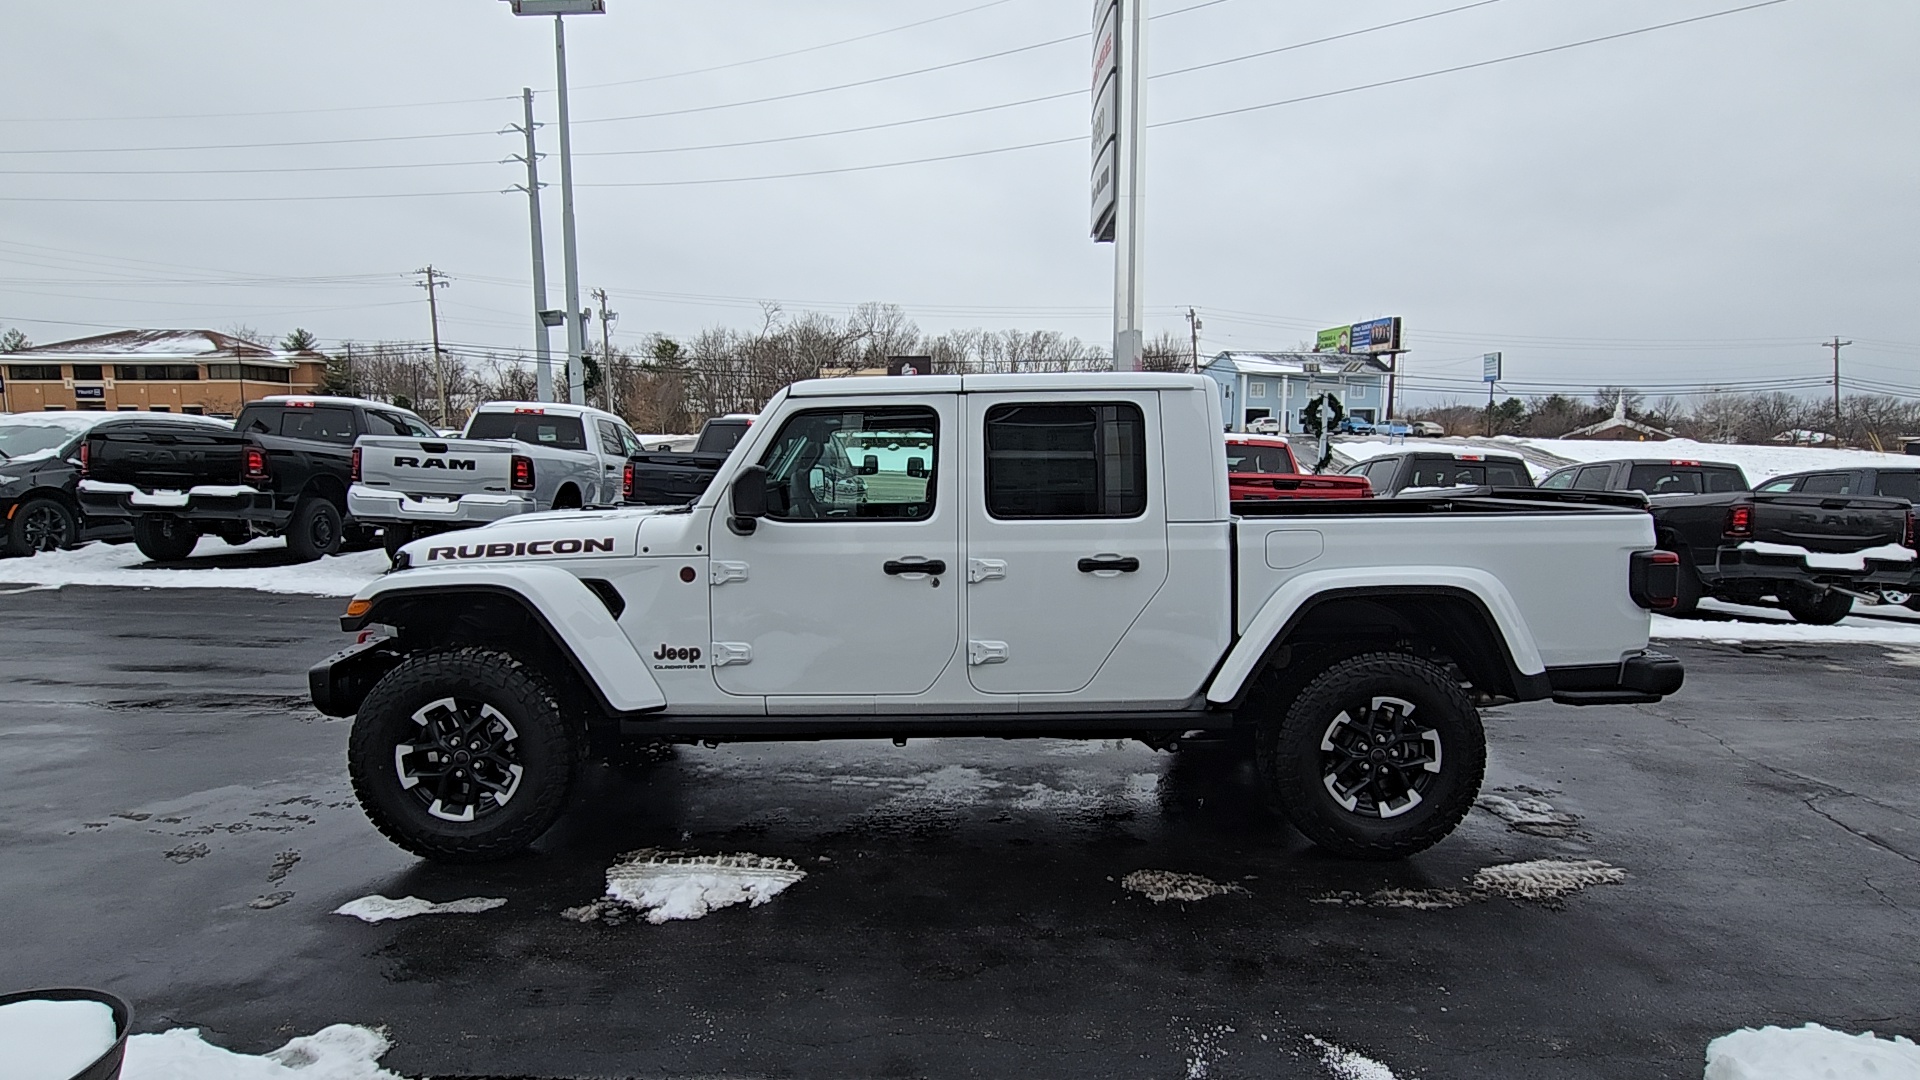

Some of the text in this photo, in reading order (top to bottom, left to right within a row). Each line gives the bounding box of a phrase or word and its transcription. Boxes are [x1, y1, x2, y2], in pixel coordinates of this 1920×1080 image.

[123, 449, 206, 464] RAM
[394, 456, 476, 471] RAM
[1791, 512, 1875, 526] RAM
[427, 537, 615, 561] RUBICON
[653, 643, 702, 663] Jeep
